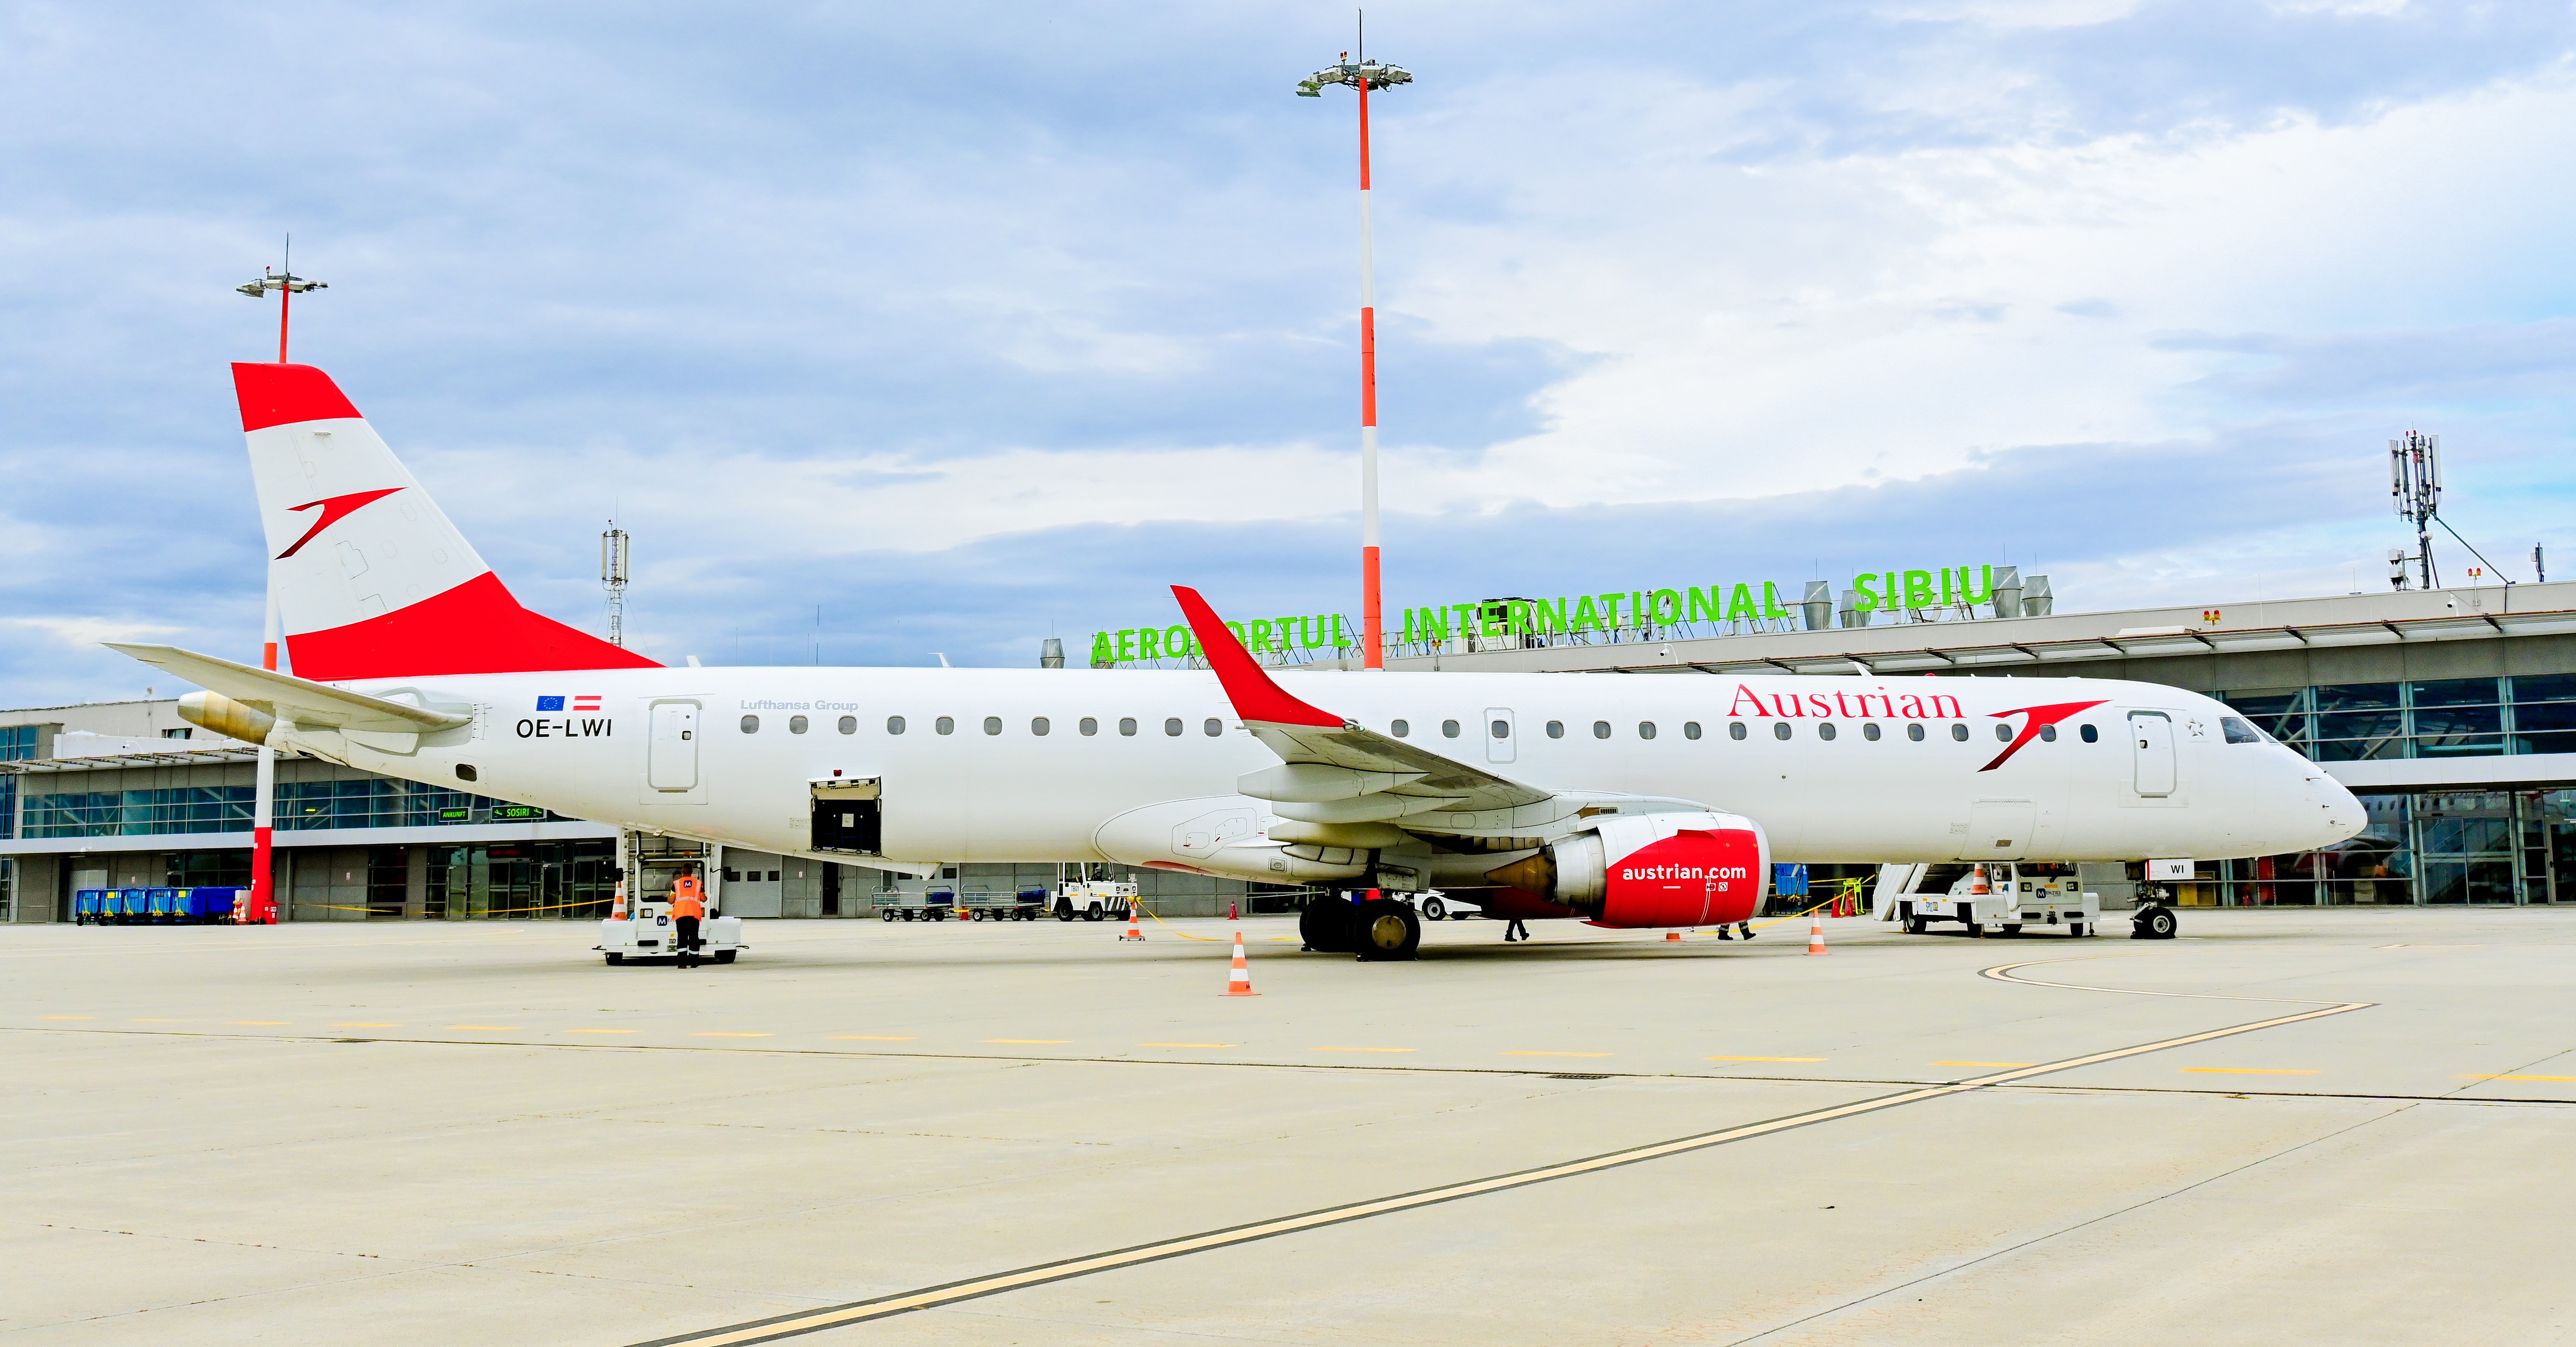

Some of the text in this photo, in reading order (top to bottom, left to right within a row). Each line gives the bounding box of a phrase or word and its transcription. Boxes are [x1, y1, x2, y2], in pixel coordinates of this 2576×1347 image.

[1090, 614, 1351, 664] AEROORTUL
[1404, 581, 1788, 643] INTERNATIONAL
[1854, 565, 1993, 612] SIBIU
[740, 700, 859, 713] Lufthansa Group
[1726, 683, 1967, 719] Austrian
[516, 719, 612, 738] OE-LWI
[507, 808, 529, 817] SOSIRI
[1622, 863, 1746, 880] austrian.com
[2170, 865, 2184, 874] WI
